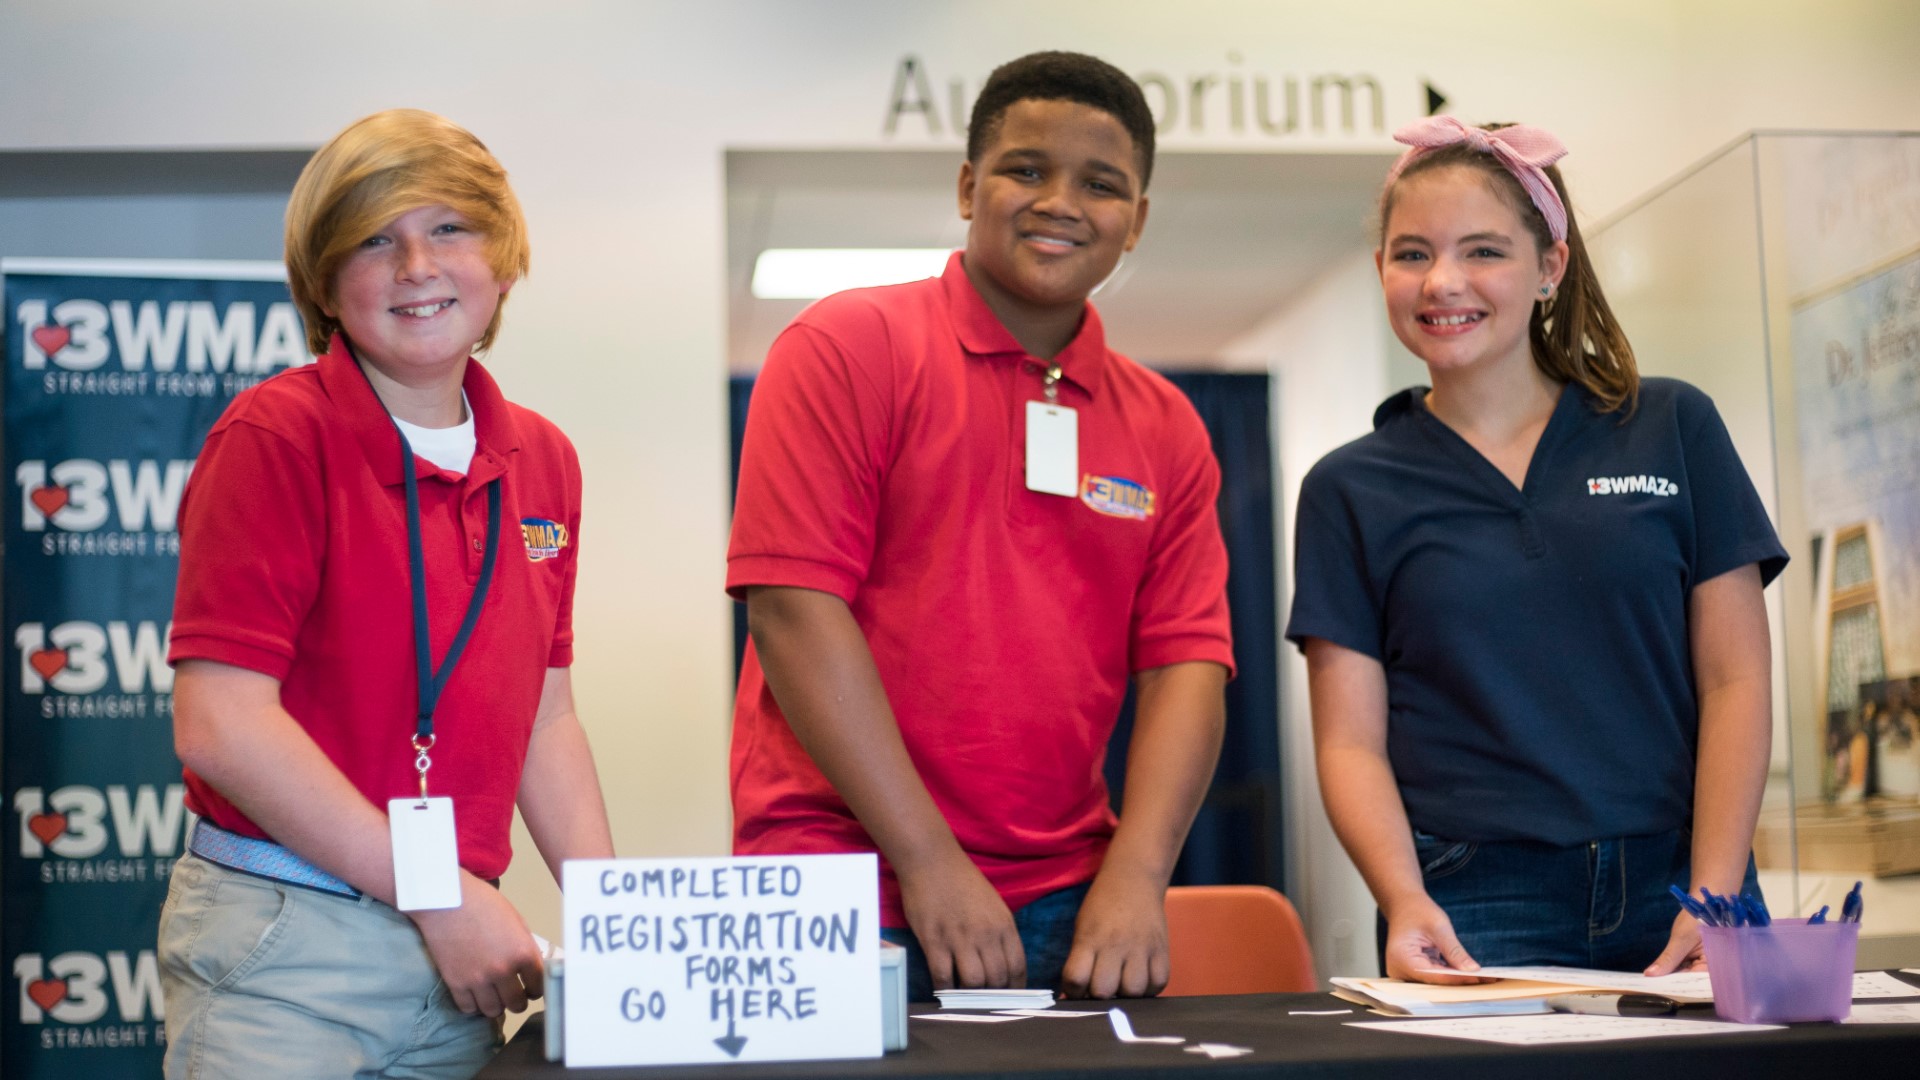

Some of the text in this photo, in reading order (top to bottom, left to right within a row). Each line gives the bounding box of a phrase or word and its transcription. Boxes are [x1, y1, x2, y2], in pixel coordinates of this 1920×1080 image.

[883, 52, 1386, 136] Auorium
[17, 299, 317, 371] 13WMA
[44, 372, 147, 394] STRAIGHT
[156, 373, 215, 397] FROM
[16, 459, 196, 531] 13W
[1587, 475, 1669, 496] 13WMAZ
[43, 532, 147, 555] STRAIGHT
[15, 621, 175, 694] 13W
[42, 696, 145, 719] STRAIGHT
[15, 785, 194, 858] 13W
[42, 860, 145, 883] STRAIGHT
[600, 865, 801, 898] COMPLETED
[580, 908, 859, 954] REGISTRATION
[685, 954, 797, 989] FORMS
[620, 987, 818, 1022] GO HERE
[42, 1025, 146, 1048] STRAIGHT
